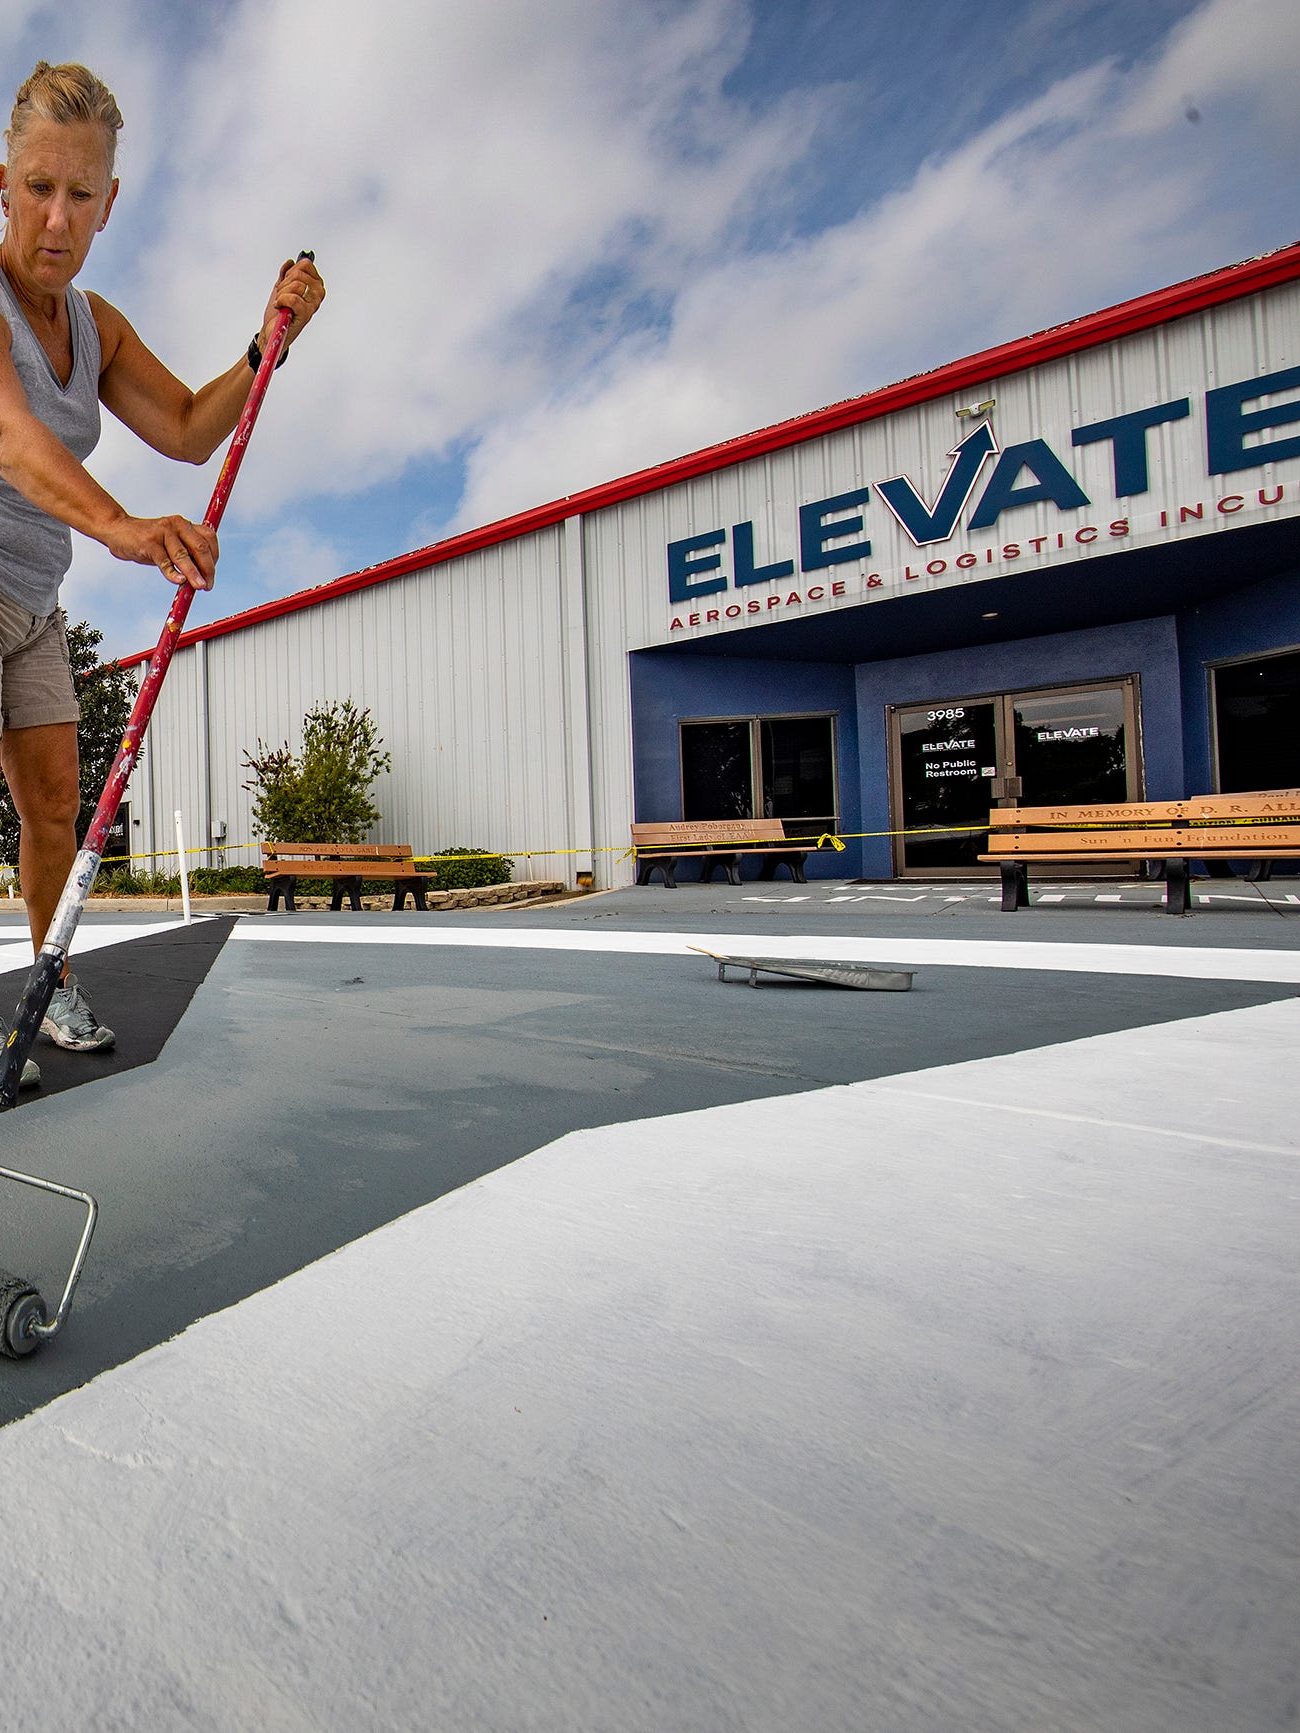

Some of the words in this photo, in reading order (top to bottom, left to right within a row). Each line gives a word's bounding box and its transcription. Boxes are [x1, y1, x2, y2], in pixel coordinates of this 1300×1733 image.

[667, 366, 1300, 603] ELEVATE
[669, 581, 846, 631] AEROSPACE
[866, 573, 883, 588] &
[905, 518, 1130, 580] LOGISTICS
[1160, 482, 1300, 527] INCU
[927, 707, 965, 721] 3985
[1037, 727, 1099, 741] ELEVATE
[922, 739, 976, 751] ELEVATE
[925, 762, 940, 770] No
[943, 759, 976, 769] Public
[925, 768, 977, 778] Restroom
[1050, 811, 1068, 820] IN
[1078, 808, 1155, 819] MEMORY
[1166, 805, 1190, 816] OF
[1200, 806, 1218, 814] D.
[1229, 804, 1249, 813] R.
[669, 823, 698, 832] Audrey
[670, 834, 691, 842] First
[693, 833, 713, 842] Lady
[1080, 837, 1108, 845] Sun
[1143, 835, 1175, 844] Fun
[1187, 832, 1289, 842] Foundation
